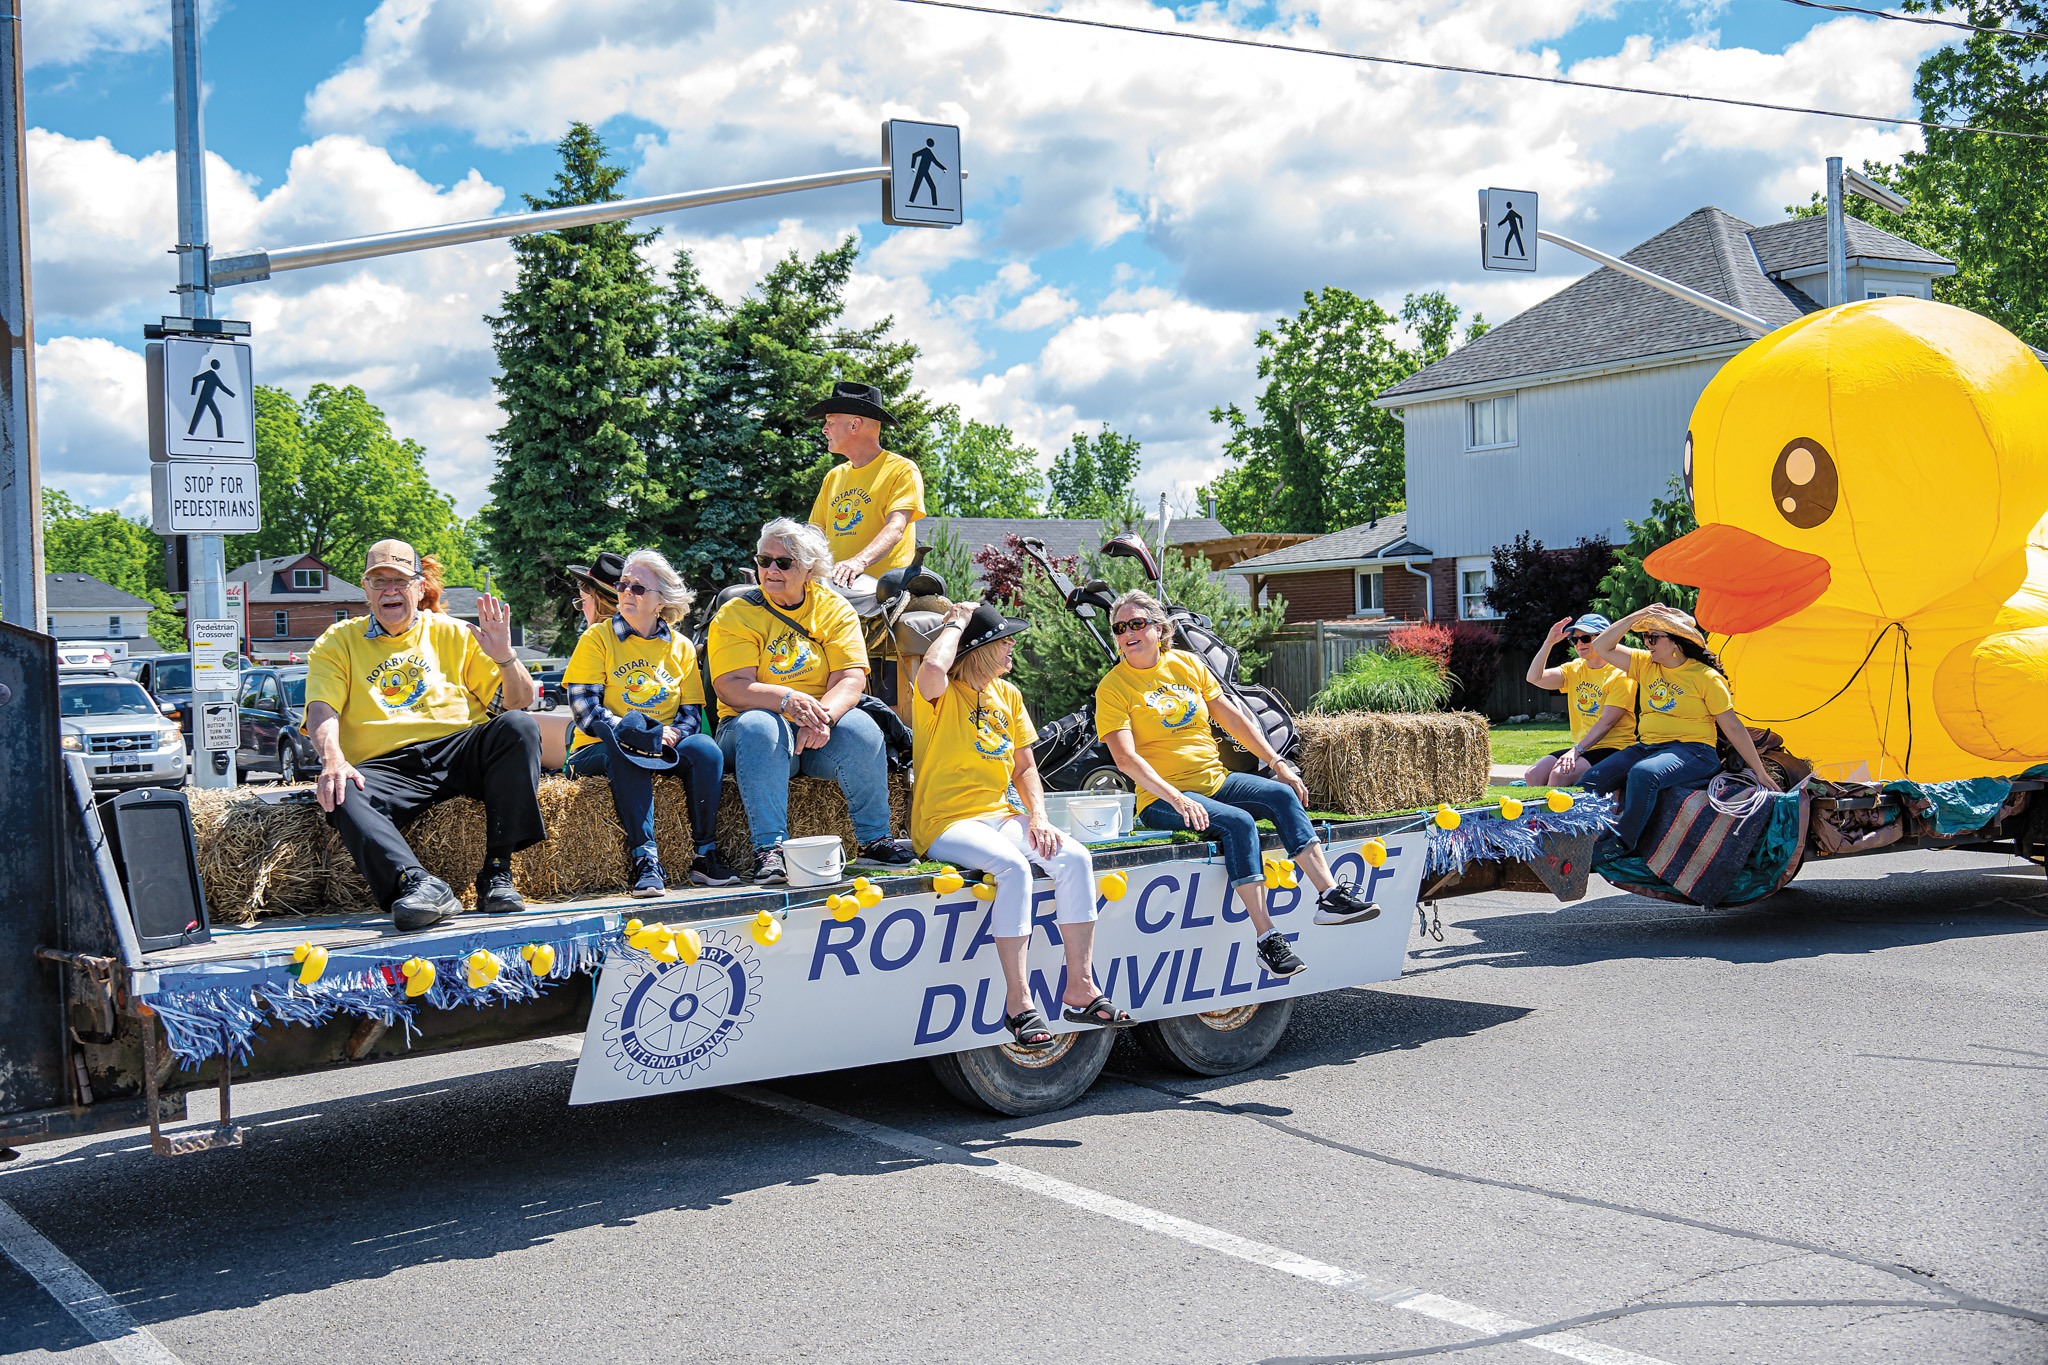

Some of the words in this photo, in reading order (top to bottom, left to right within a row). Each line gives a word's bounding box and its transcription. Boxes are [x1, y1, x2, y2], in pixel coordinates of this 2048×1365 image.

[184, 476, 213, 493] STOP
[220, 477, 243, 493] FOR
[830, 488, 857, 507] ROTARY
[856, 488, 871, 504] CLUB
[174, 500, 255, 517] PEDESTRIANS
[366, 657, 406, 684] ROTARY
[407, 654, 431, 673] CLUB
[613, 659, 649, 678] ROTARY
[788, 666, 814, 679] DUNNVILLE
[1171, 683, 1194, 695] CLUB
[1576, 681, 1594, 692] ROARY
[992, 710, 1009, 728] CLUB
[1330, 847, 1403, 903] OF
[665, 947, 729, 970] RARY
[624, 1025, 732, 1069] INTERNATIONAL
